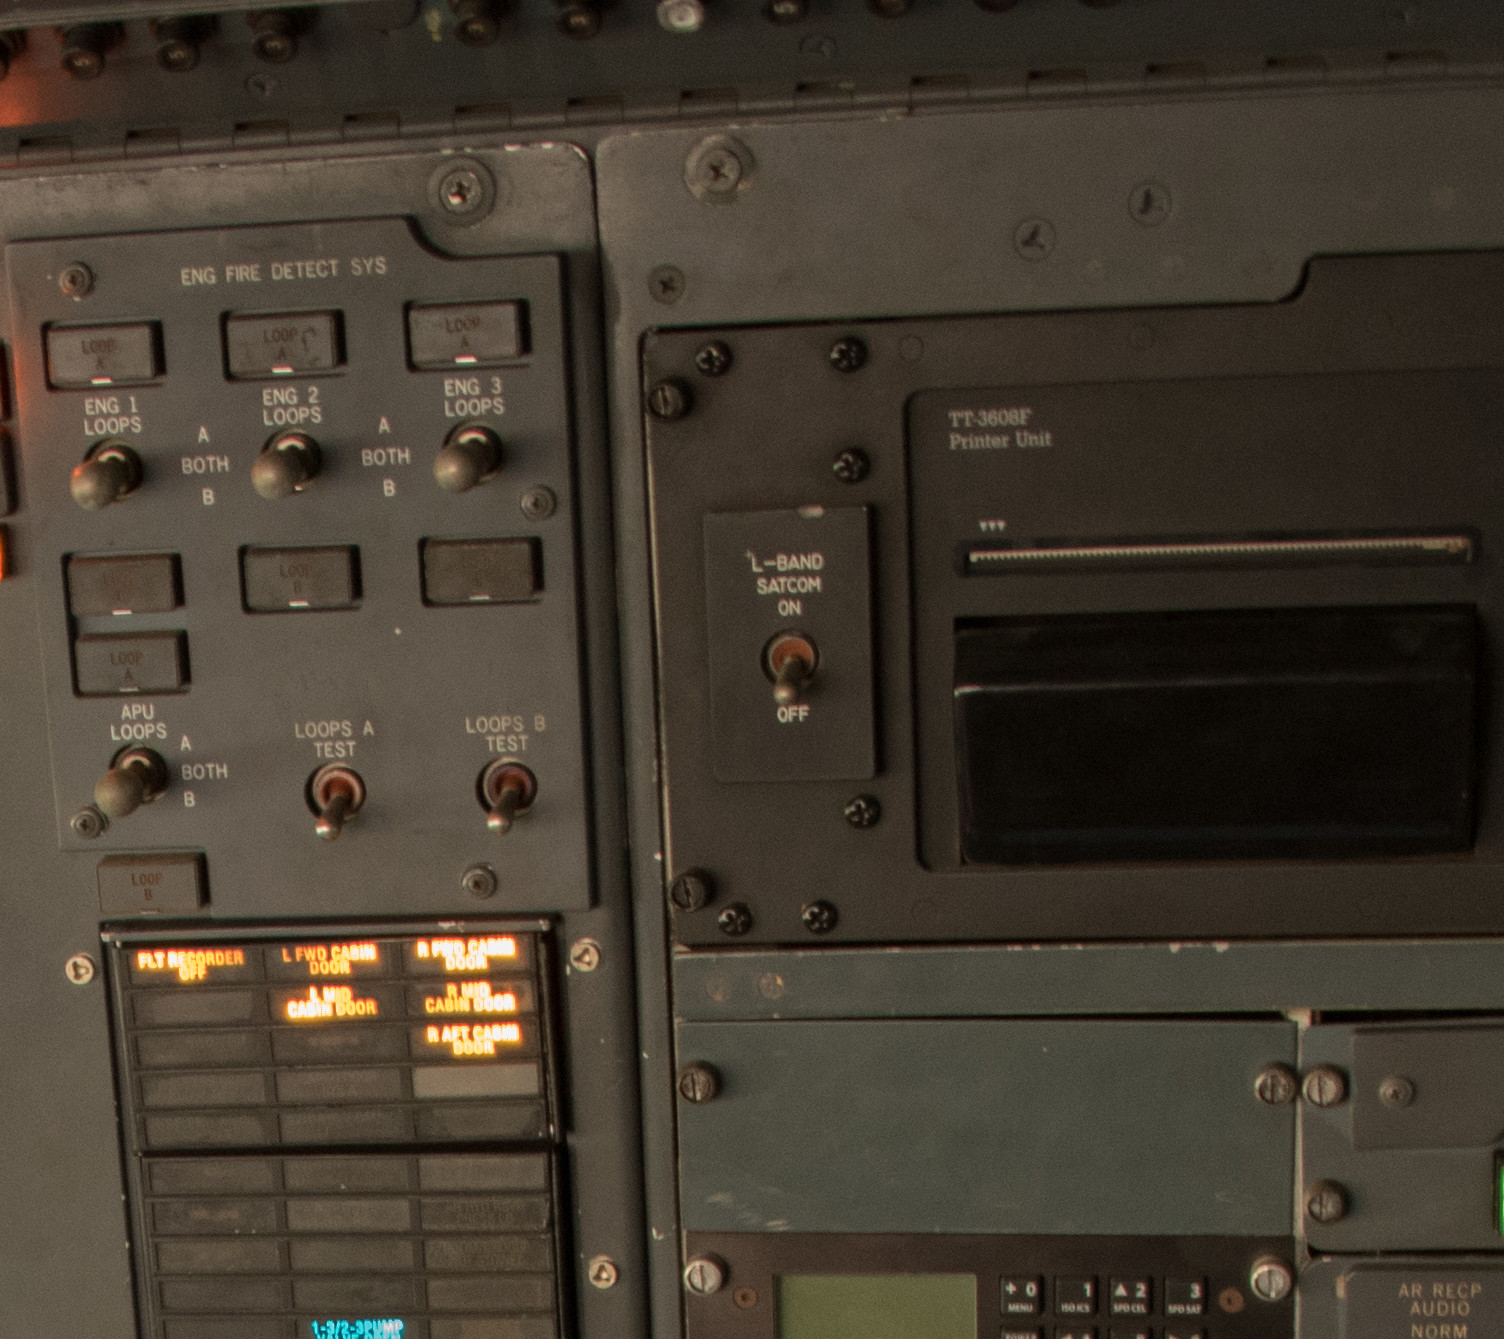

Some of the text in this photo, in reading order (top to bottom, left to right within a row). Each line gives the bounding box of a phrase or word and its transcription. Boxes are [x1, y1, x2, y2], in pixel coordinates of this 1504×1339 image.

[181, 258, 387, 286] ENG FIRE DETECT SYS
[262, 387, 318, 406] ENG 2
[85, 397, 137, 416] ENG 1
[262, 407, 321, 425] LOOPS
[84, 417, 142, 435] LOOPS
[949, 429, 1052, 450] Printer Unit
[182, 457, 229, 474] BOTH
[751, 553, 823, 573] L-BAND
[757, 576, 822, 594] SATCOM
[778, 600, 802, 616] ON
[121, 704, 155, 719] APU
[777, 705, 809, 723] OFF
[111, 722, 167, 740] LOOPS
[295, 720, 375, 738] LOOPS A
[314, 740, 357, 758] TEST
[137, 949, 244, 968] FLT RECORDER
[1410, 1302, 1471, 1318] AUDIO
[1411, 1323, 1467, 1339] NORM
